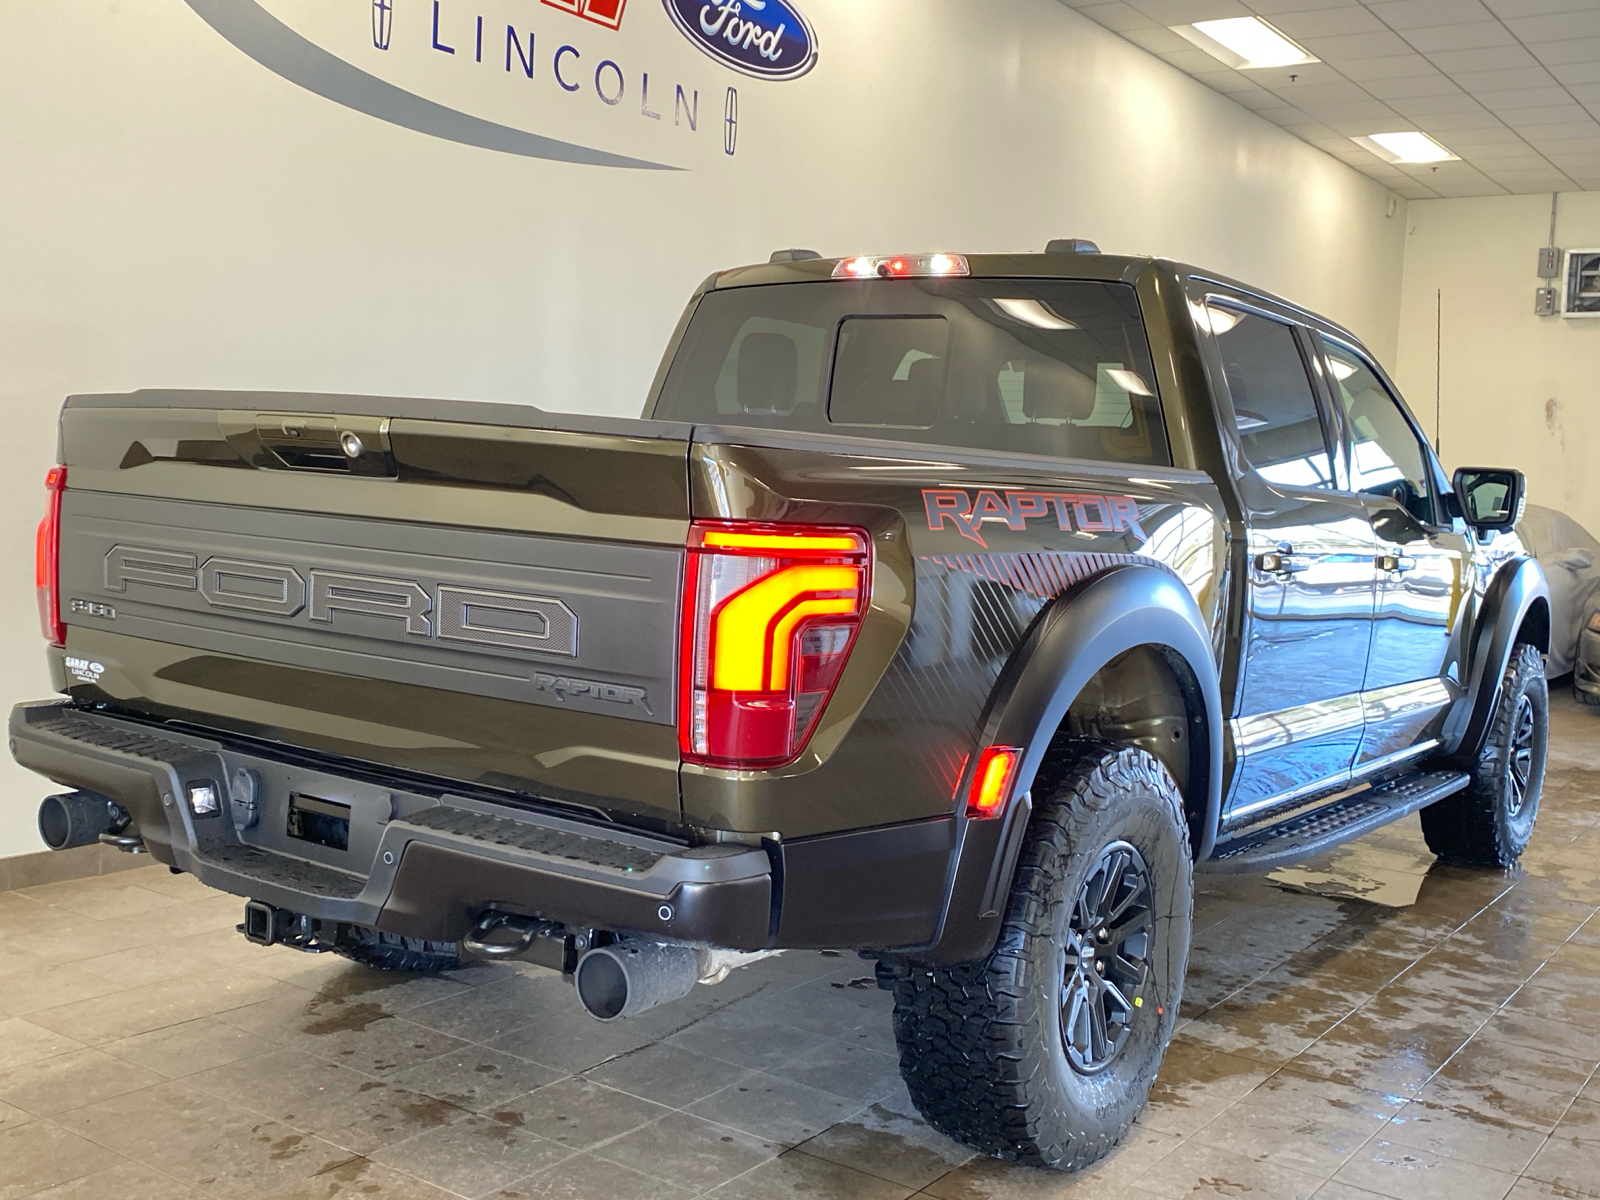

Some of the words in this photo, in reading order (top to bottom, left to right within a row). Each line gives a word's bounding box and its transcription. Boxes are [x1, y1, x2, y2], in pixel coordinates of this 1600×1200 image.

[699, 0, 786, 61] Ford
[432, 0, 699, 131] LINCOLN
[920, 488, 1148, 549] RAPTOR
[104, 543, 580, 659] FORD
[71, 668, 100, 679] LINCOLN
[534, 671, 655, 717] RAPTOR
